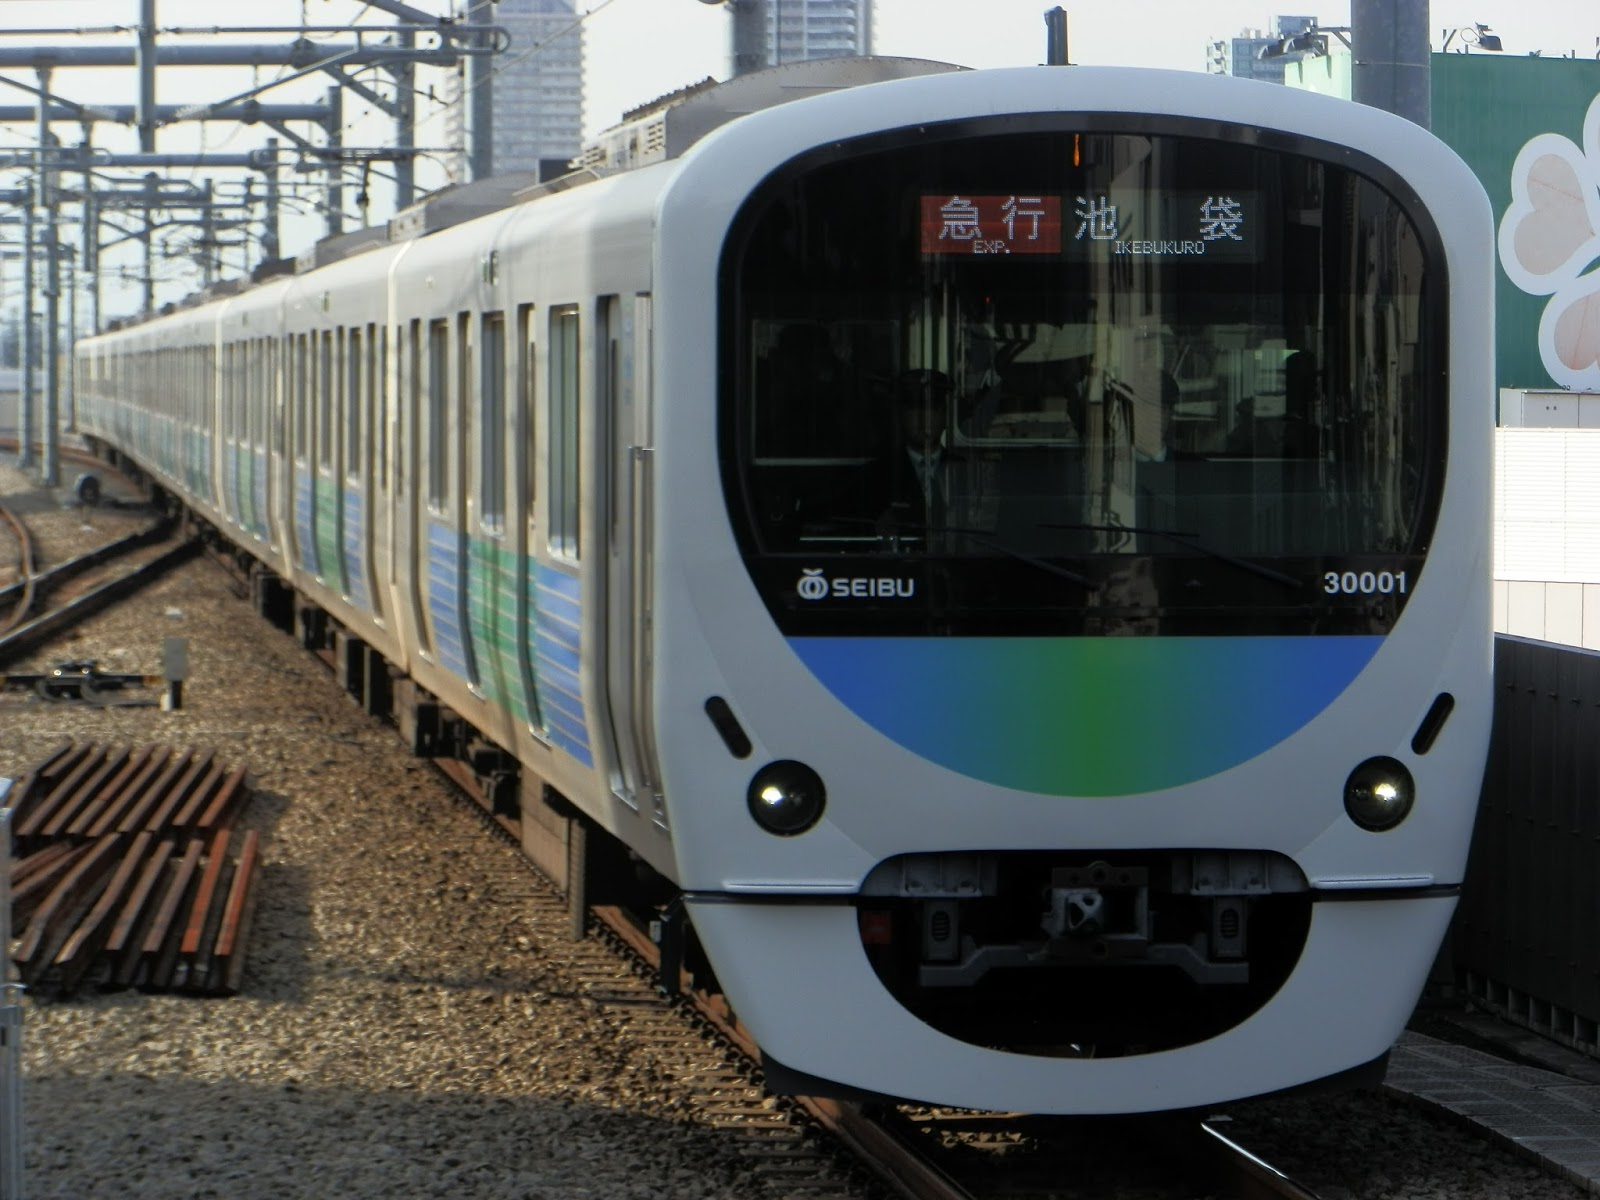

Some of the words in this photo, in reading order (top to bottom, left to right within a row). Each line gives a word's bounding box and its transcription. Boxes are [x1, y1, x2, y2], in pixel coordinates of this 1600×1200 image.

[939, 196, 1045, 240] 急行
[1075, 196, 1243, 241] 池袋
[973, 240, 1011, 254] EXP.
[1114, 240, 1206, 254] IKEBUKURO
[832, 578, 915, 597] SEIBU
[1324, 571, 1406, 594] 30001
